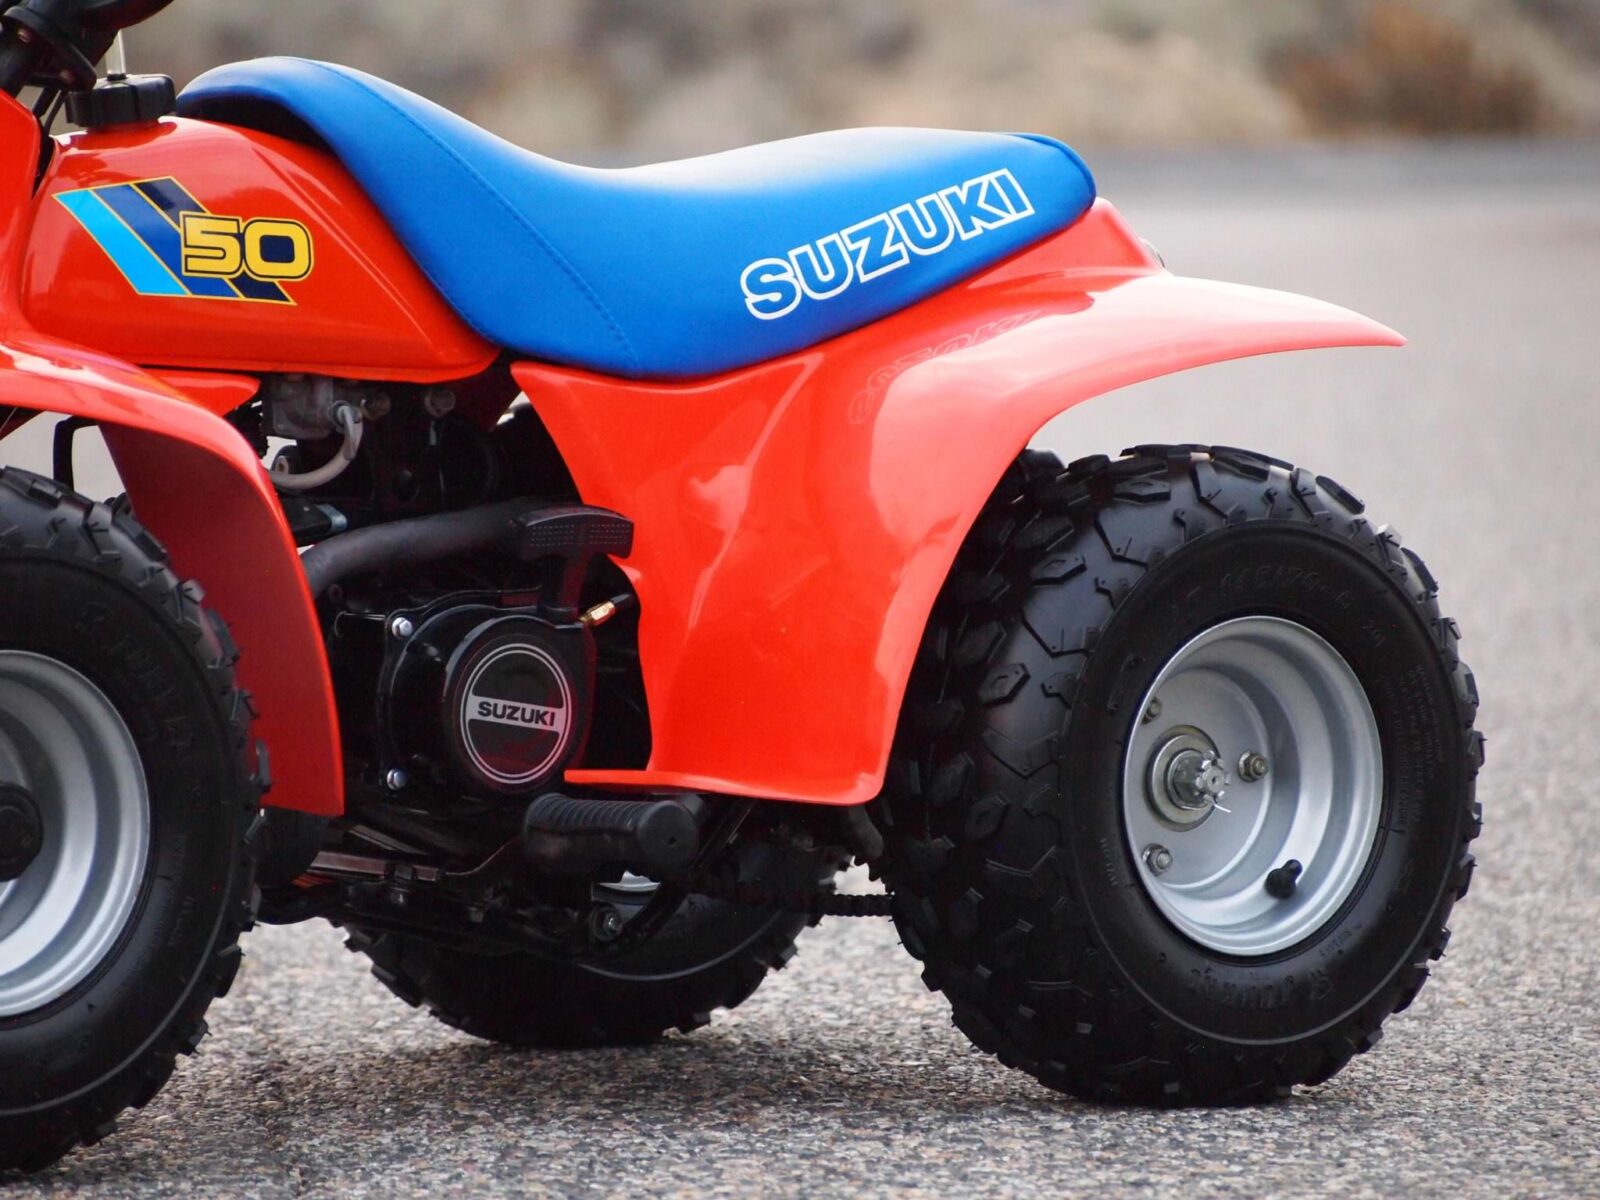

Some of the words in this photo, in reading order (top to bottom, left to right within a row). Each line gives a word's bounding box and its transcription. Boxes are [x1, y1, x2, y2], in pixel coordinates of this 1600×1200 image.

[179, 211, 314, 281] 50
[740, 168, 1035, 320] SUZUKI
[478, 701, 556, 727] SUZUKI
